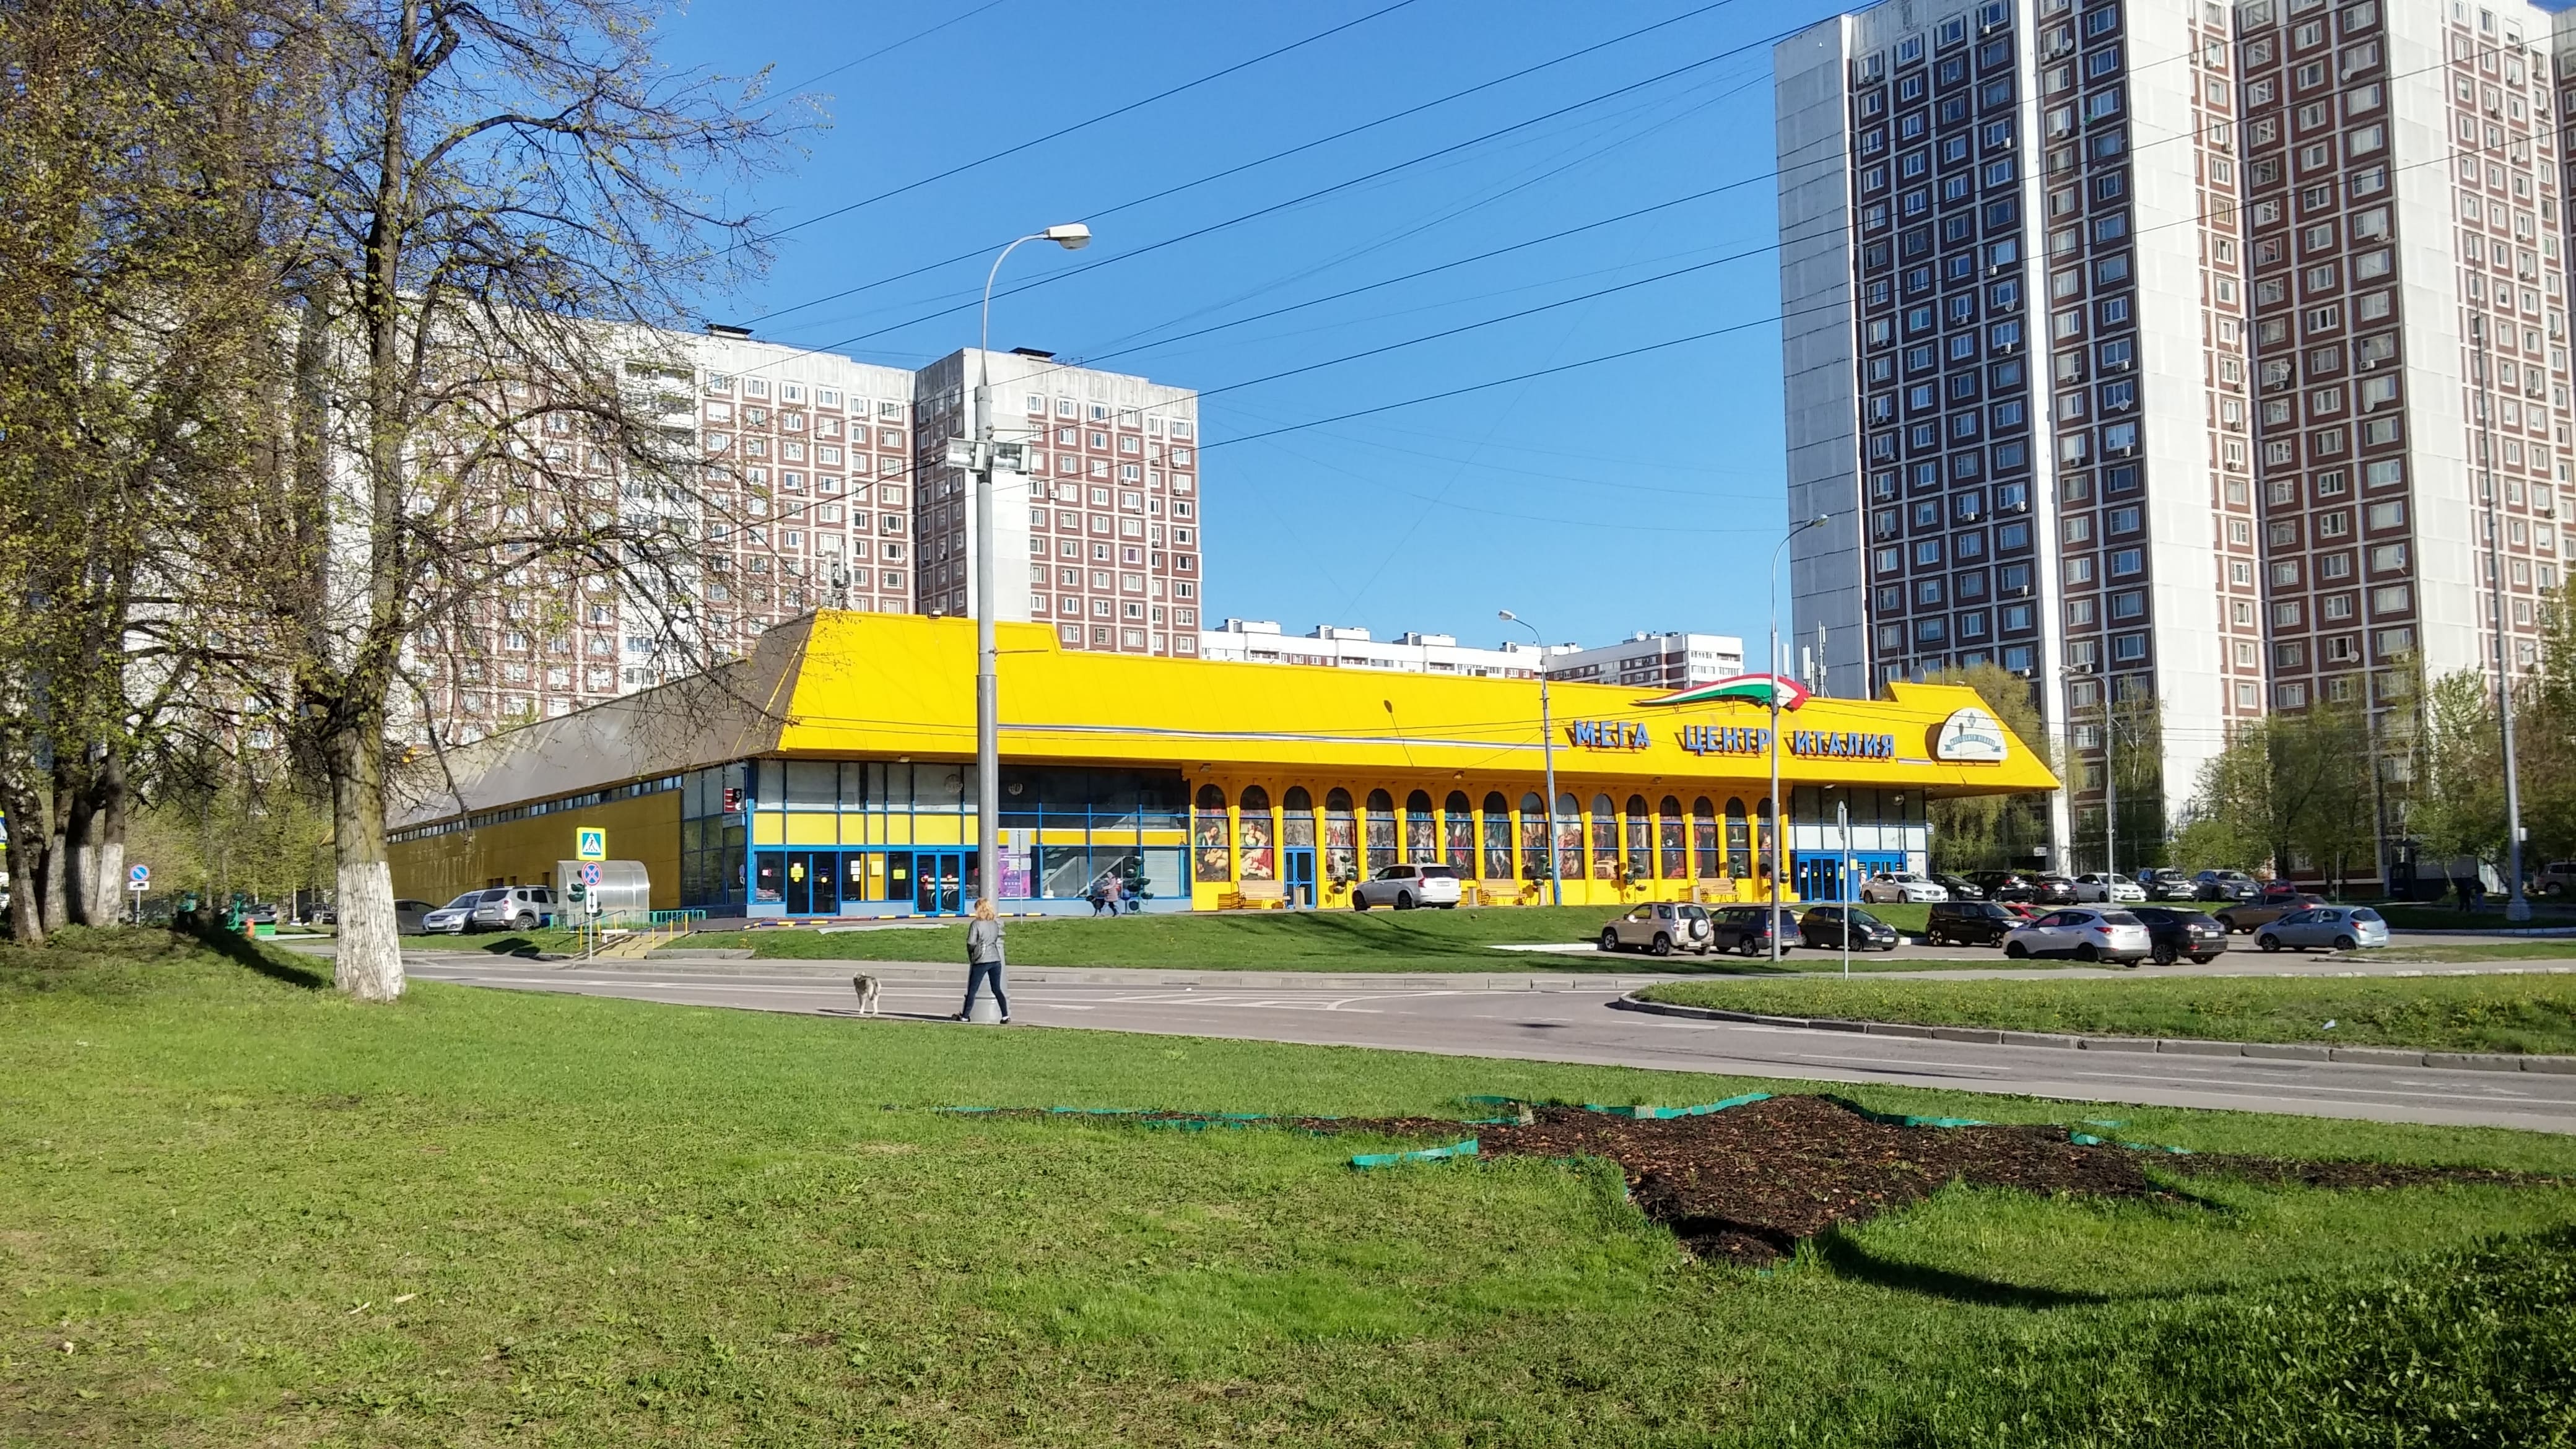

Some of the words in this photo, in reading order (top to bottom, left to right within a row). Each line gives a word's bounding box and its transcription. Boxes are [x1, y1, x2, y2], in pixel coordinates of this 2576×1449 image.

[1573, 720, 1651, 747] МЕГА
[1684, 724, 1771, 755] ЦЕНТР
[1793, 730, 1895, 757] ИТАЛИЯ
